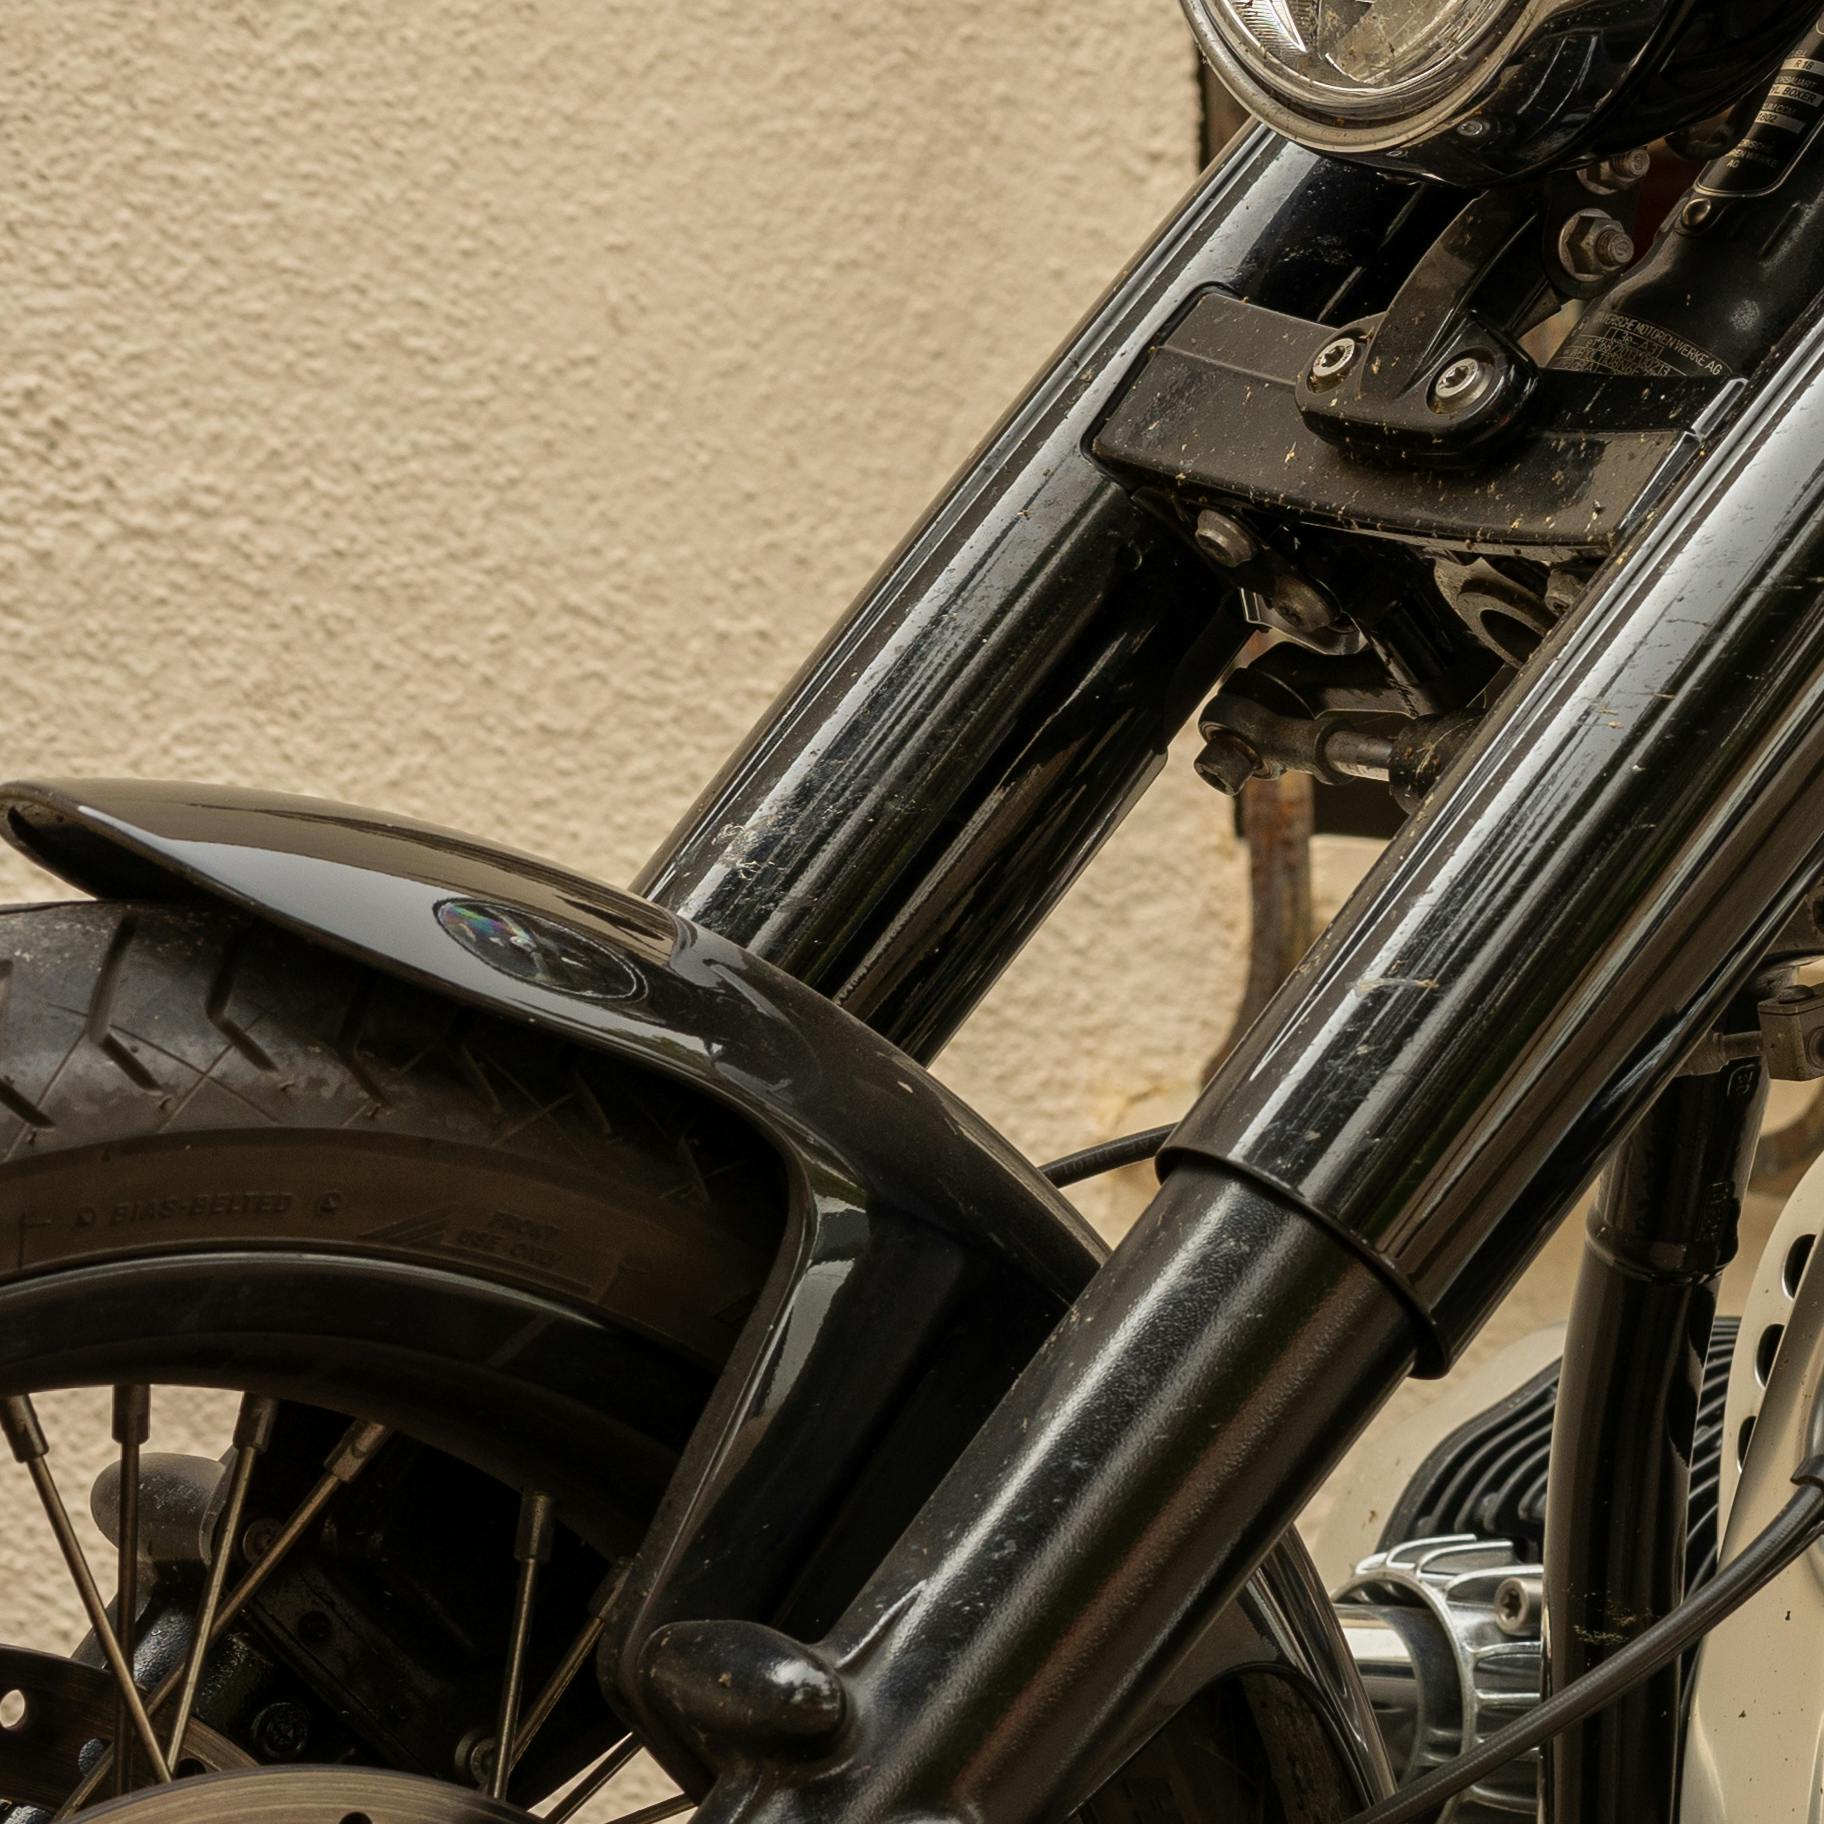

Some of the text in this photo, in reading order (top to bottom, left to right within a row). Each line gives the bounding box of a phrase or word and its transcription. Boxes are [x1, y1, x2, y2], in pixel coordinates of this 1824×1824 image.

[1783, 86, 1817, 102] BOXER
[1676, 341, 1710, 367] WERKE
[1705, 360, 1723, 376] AG
[109, 1191, 294, 1227] BIAS-BELTED
